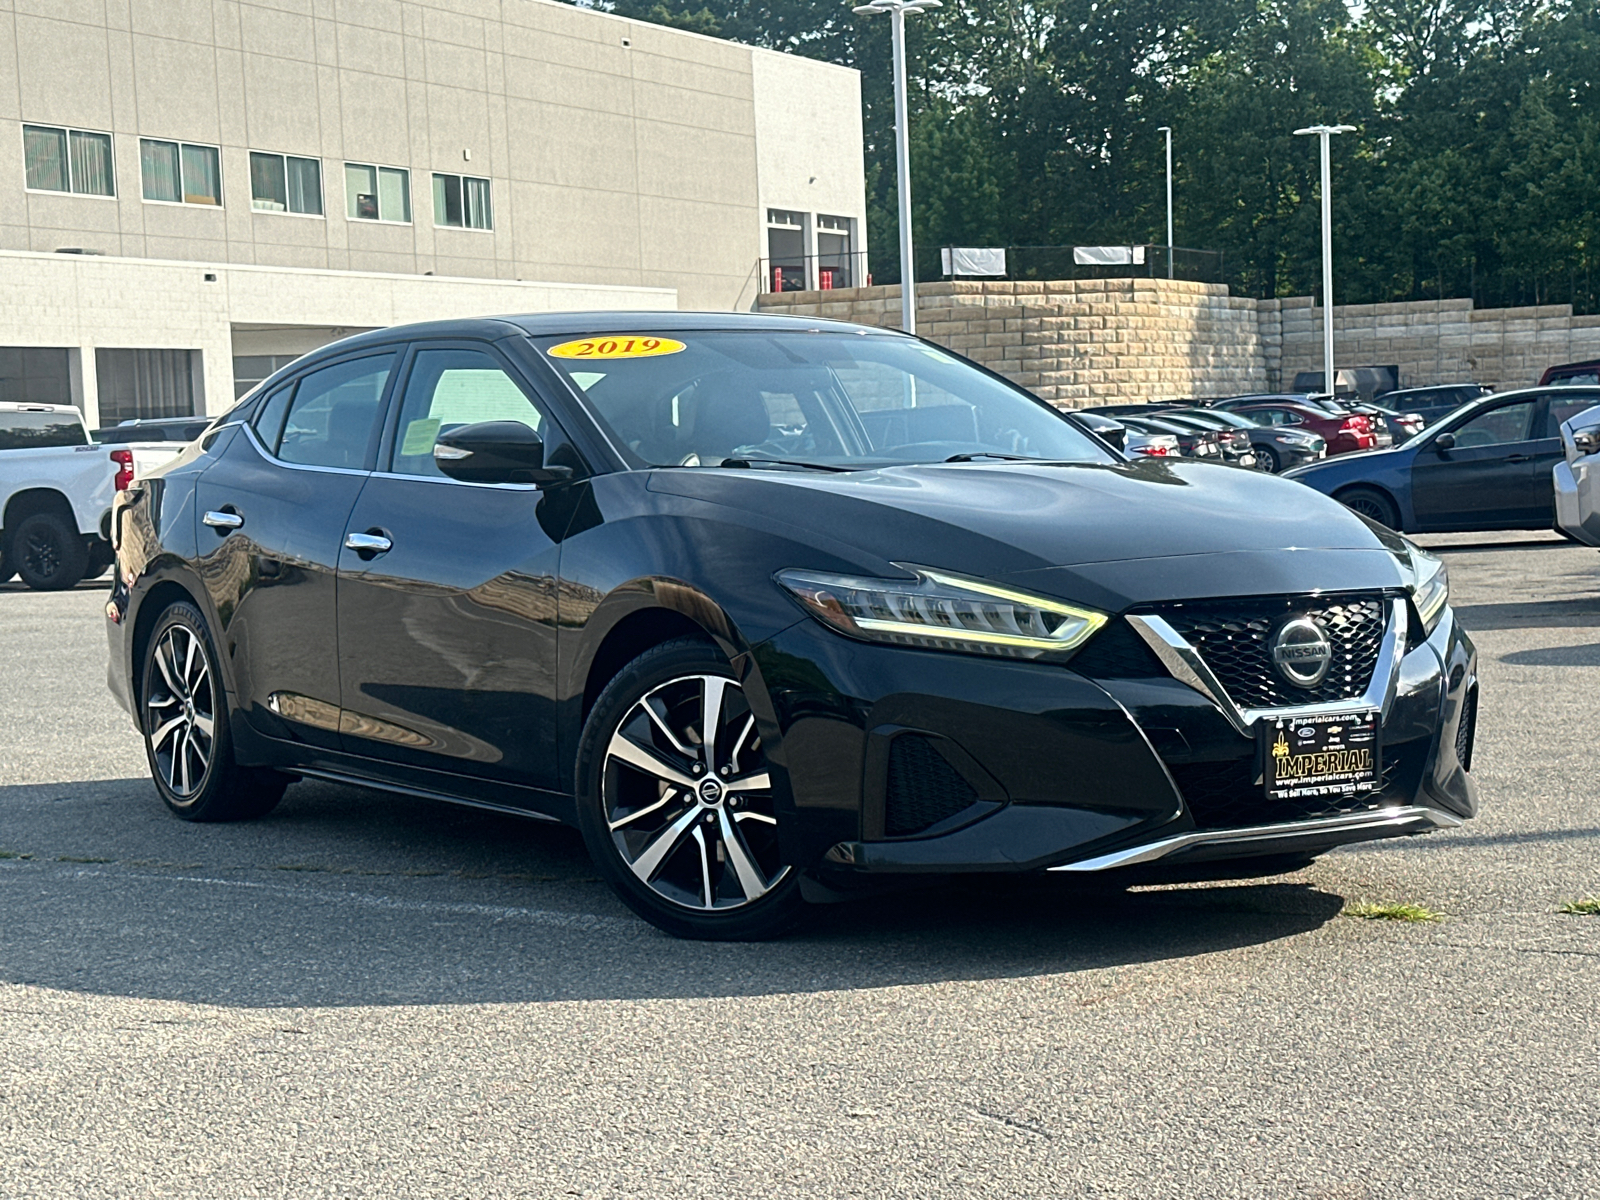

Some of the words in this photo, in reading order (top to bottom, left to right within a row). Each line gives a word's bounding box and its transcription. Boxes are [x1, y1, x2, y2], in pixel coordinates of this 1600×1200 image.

[575, 339, 661, 356] 2019
[1281, 646, 1326, 659] NISSAN
[1276, 749, 1373, 778] IMPERIAL
